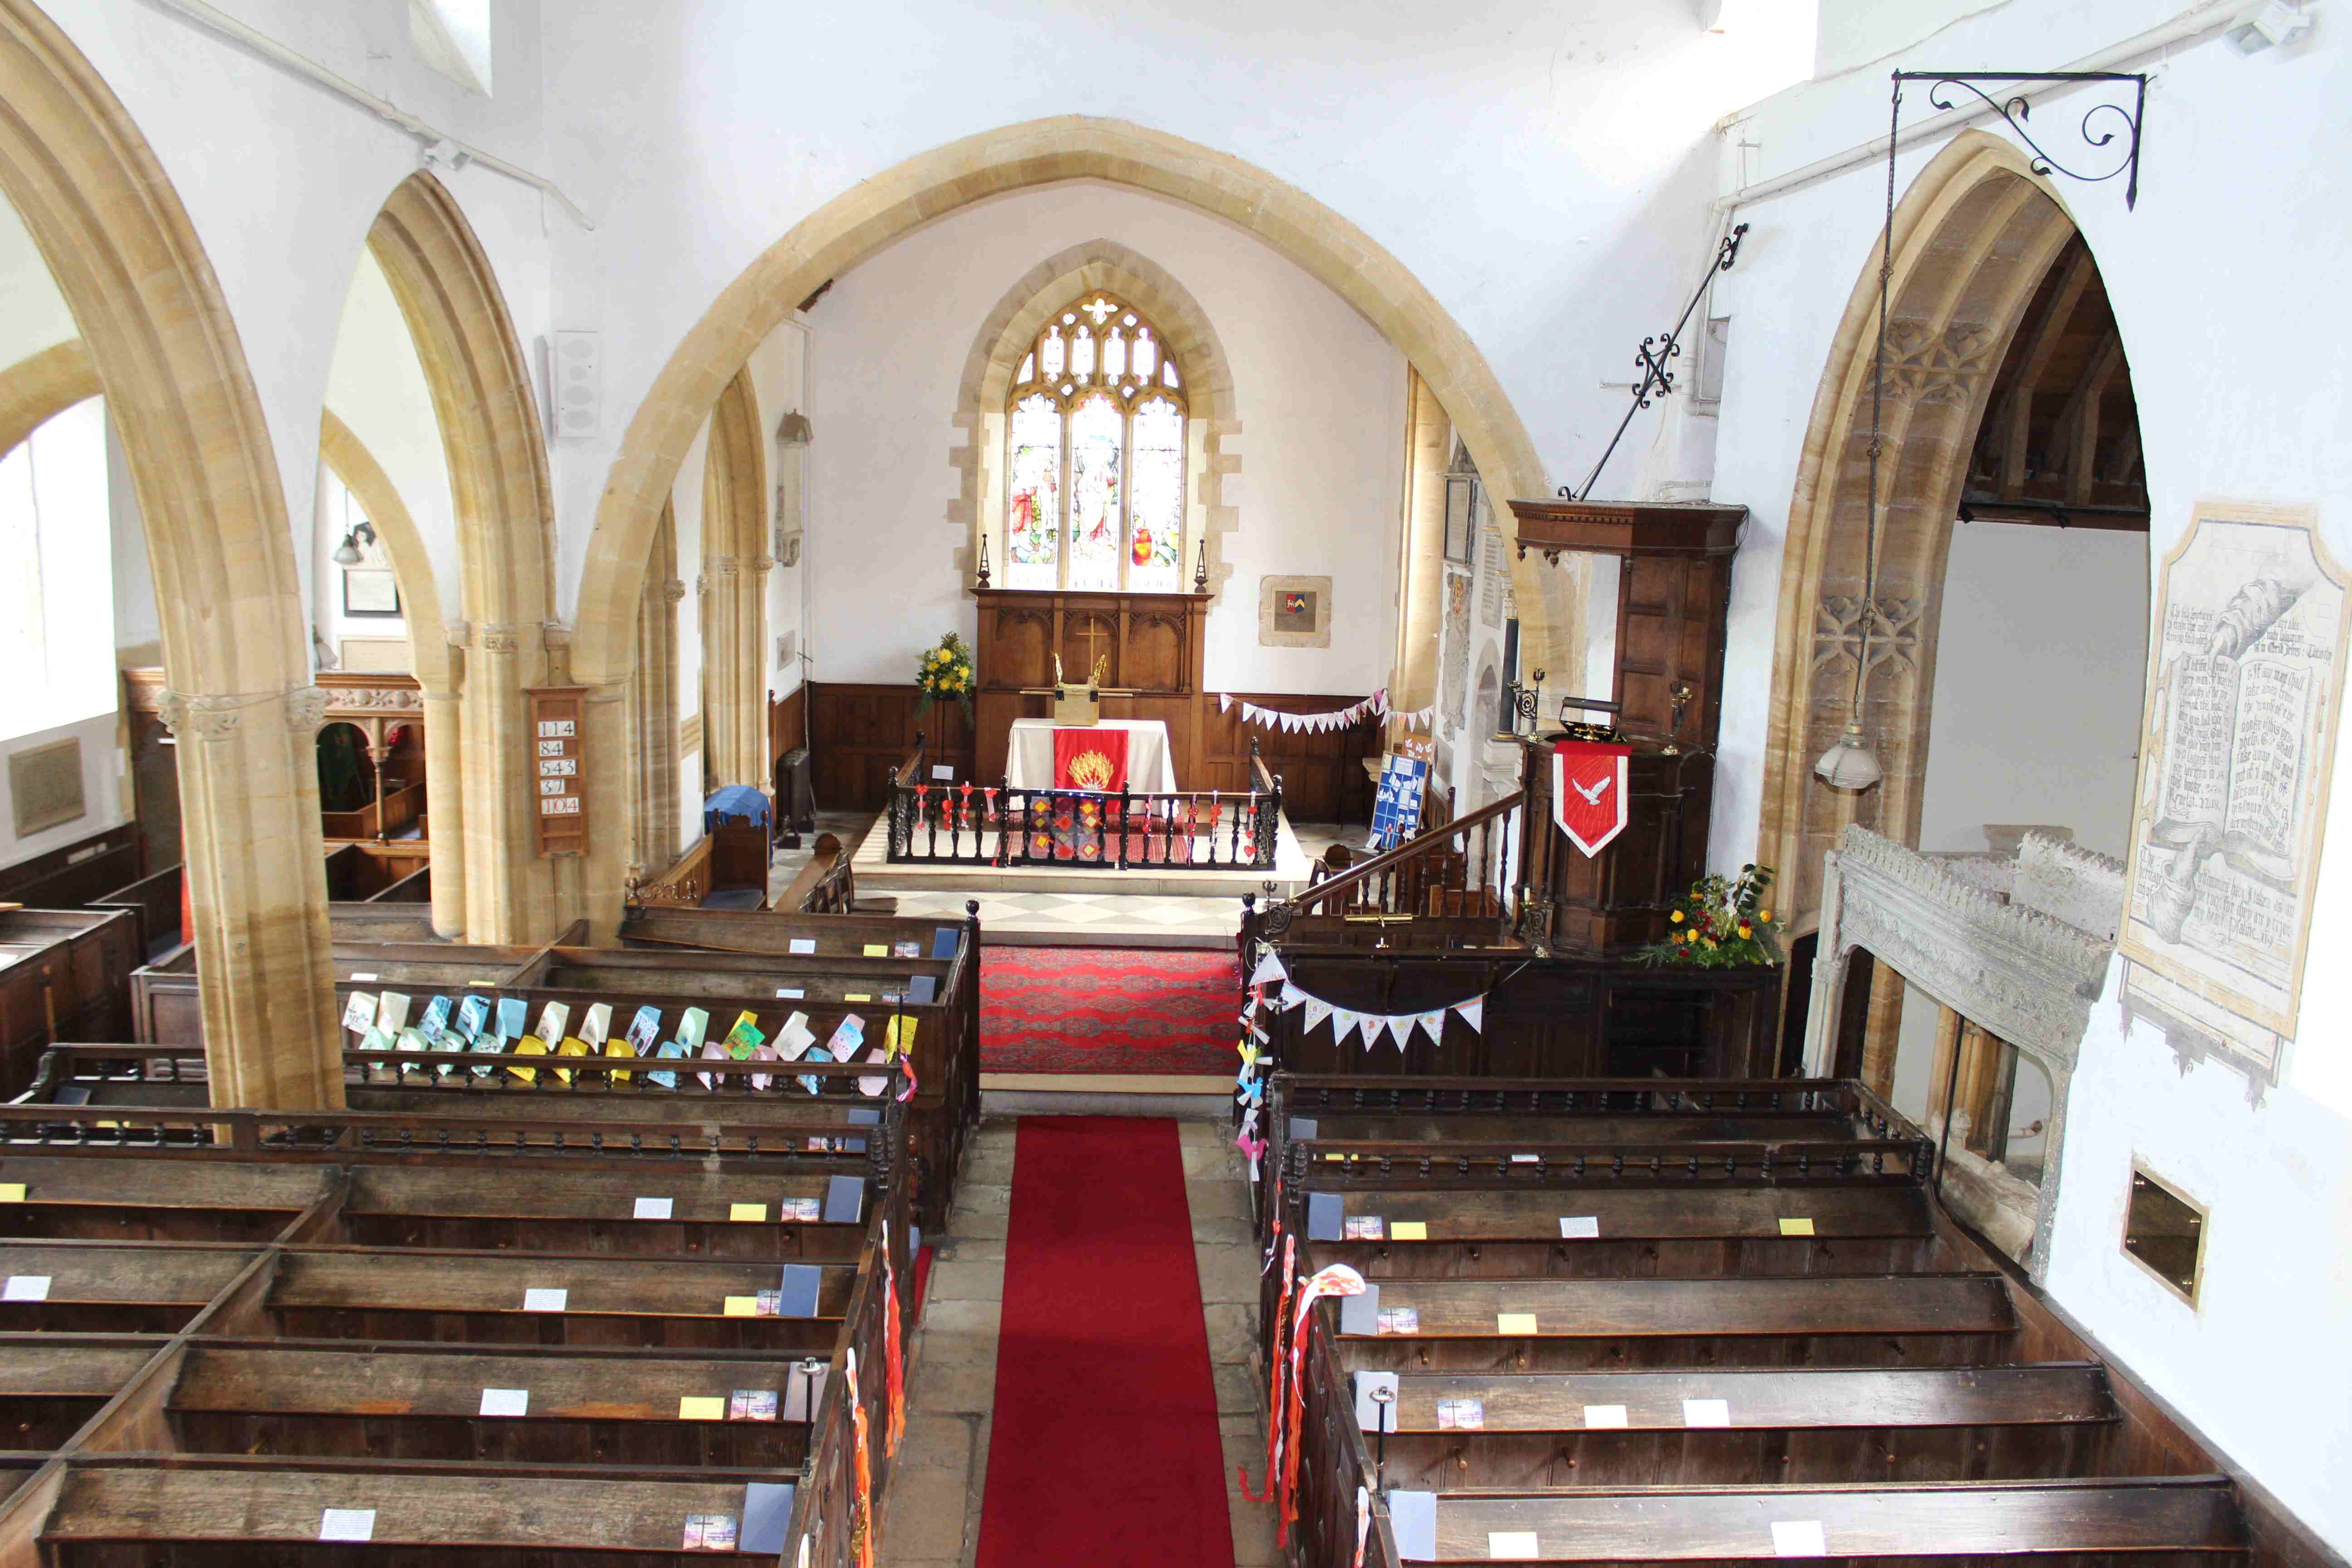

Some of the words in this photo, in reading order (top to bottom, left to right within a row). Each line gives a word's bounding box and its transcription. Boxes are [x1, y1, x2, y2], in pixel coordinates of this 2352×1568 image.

[540, 723, 573, 736] 114
[541, 742, 563, 756] 84
[542, 760, 574, 776] 543
[543, 780, 563, 794] 37
[545, 799, 578, 813] 104
